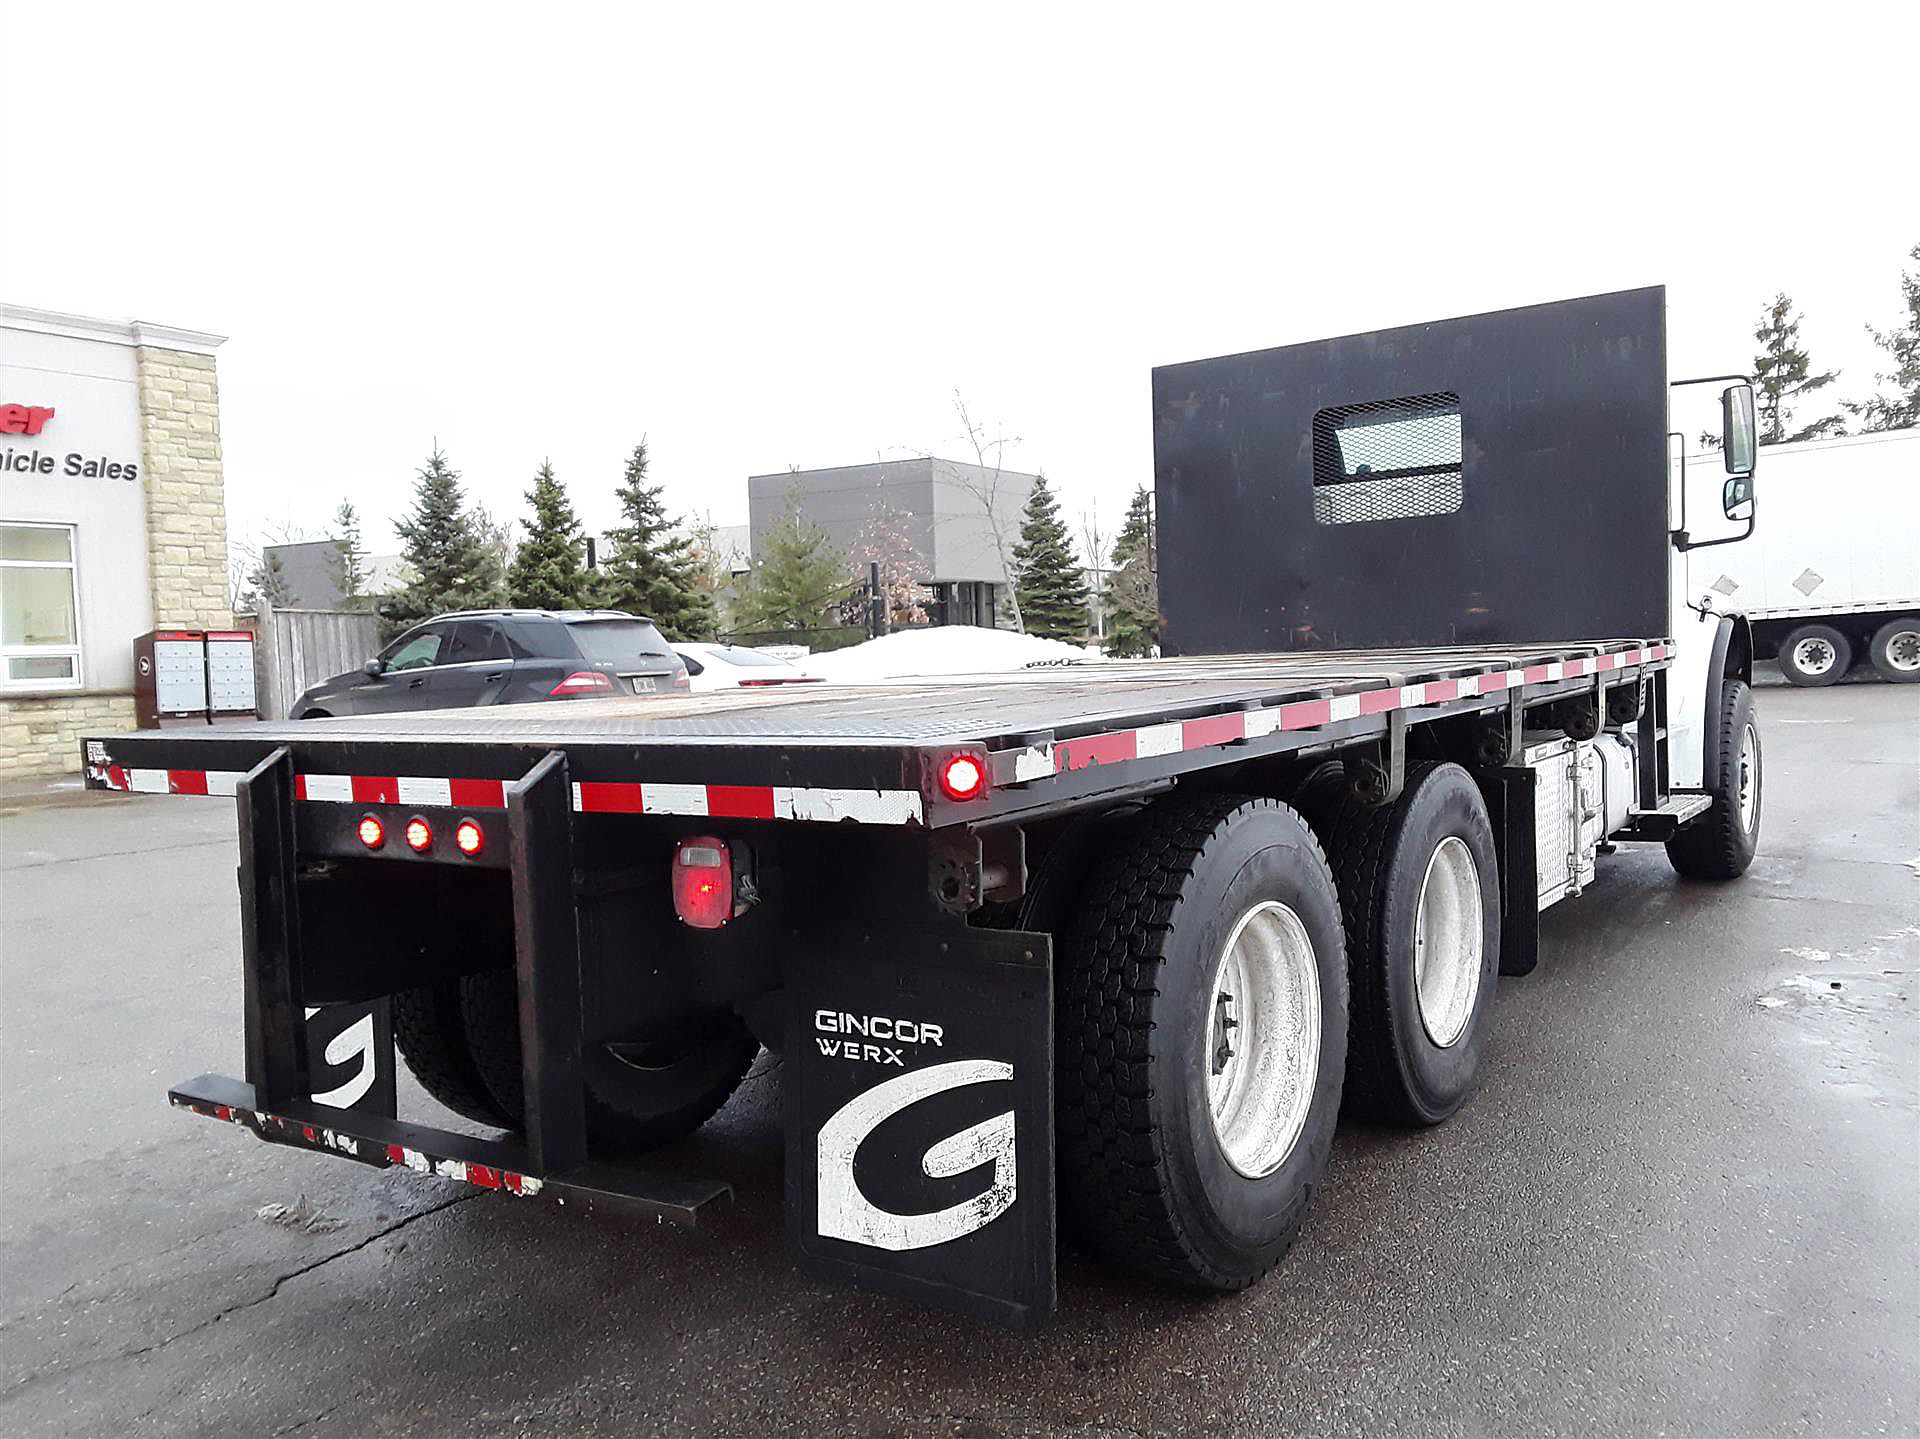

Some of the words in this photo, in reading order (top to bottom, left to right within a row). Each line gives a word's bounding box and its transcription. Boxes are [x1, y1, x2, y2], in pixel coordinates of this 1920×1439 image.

[0, 447, 55, 474] icle
[63, 453, 138, 481] Sales
[815, 1009, 944, 1047] GINCOR
[815, 1037, 905, 1067] WERX
